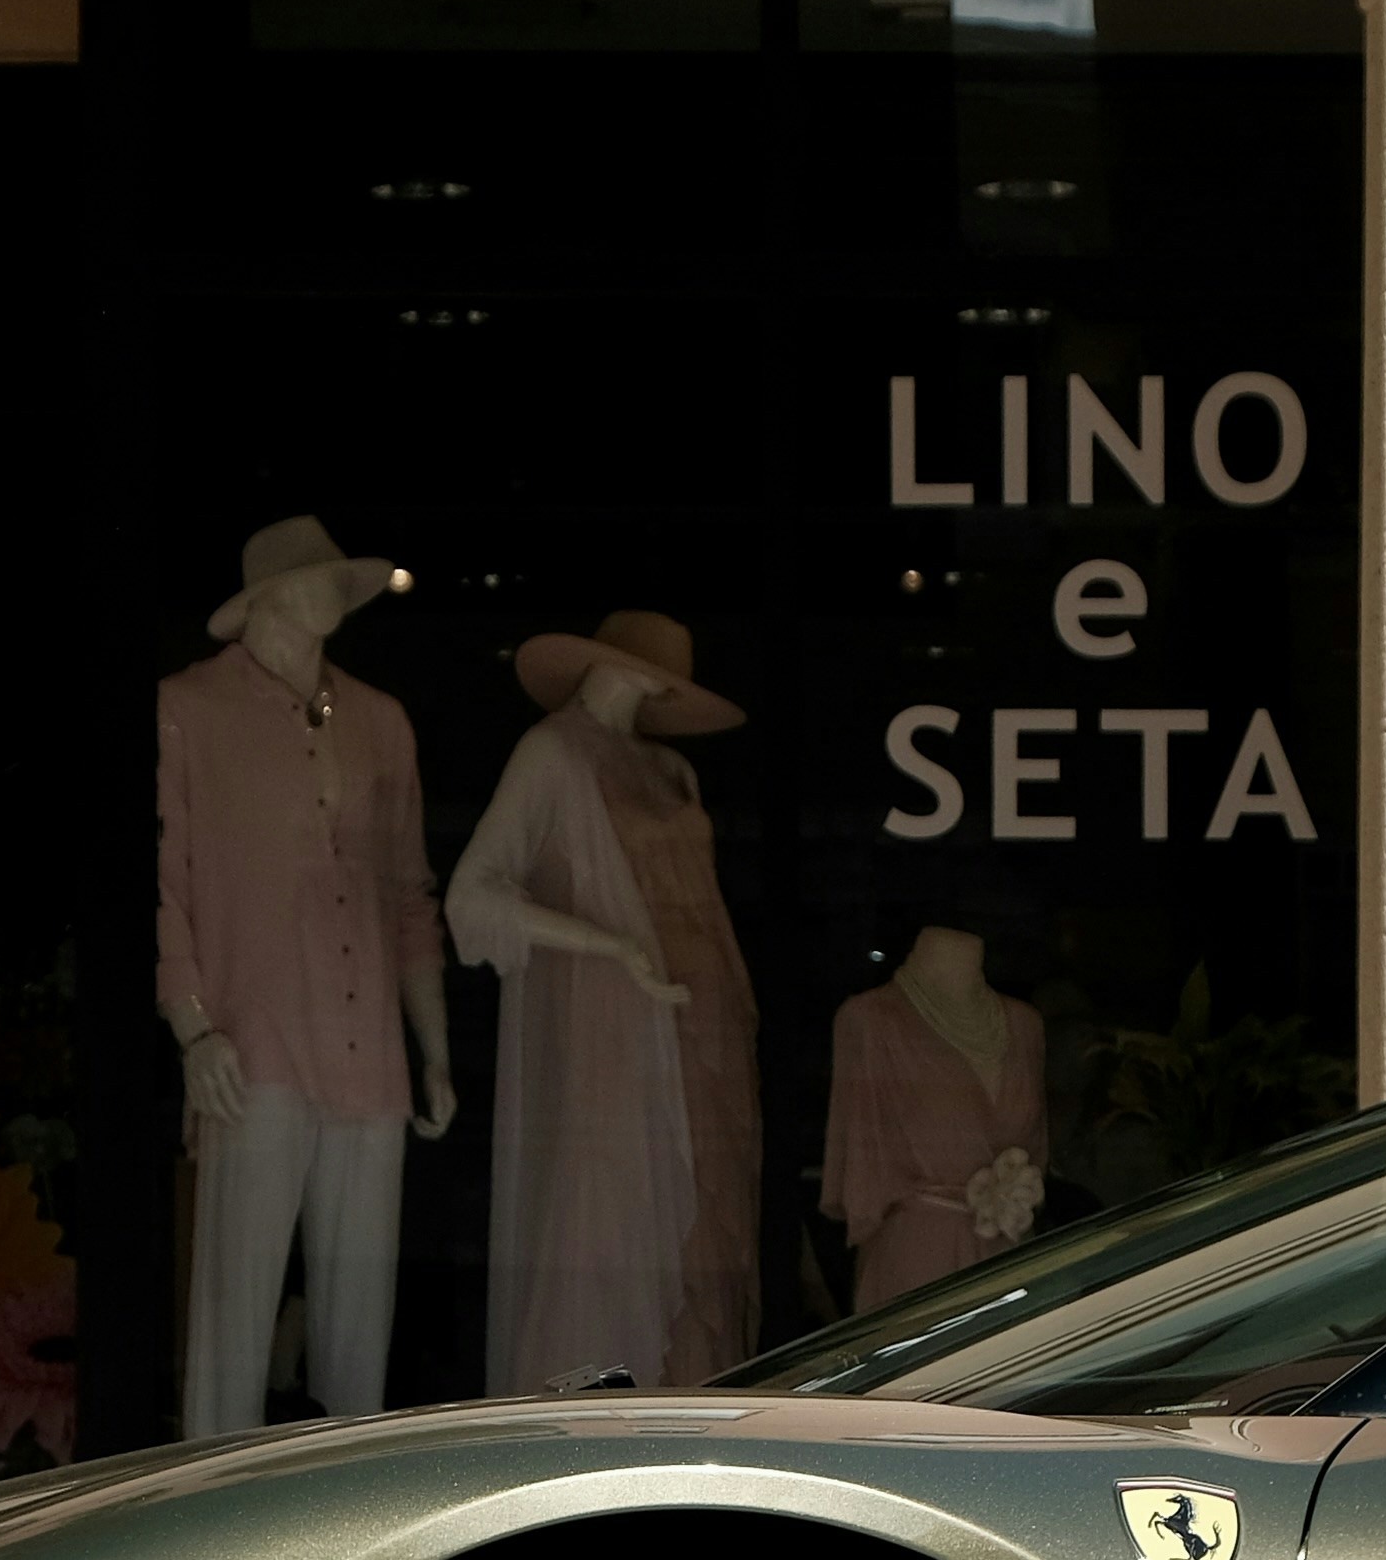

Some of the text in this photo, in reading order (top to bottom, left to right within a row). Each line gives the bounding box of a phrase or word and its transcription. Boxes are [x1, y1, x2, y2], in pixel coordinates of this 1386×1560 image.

[890, 371, 1308, 506] LINO
[1053, 558, 1149, 659] e
[883, 704, 1319, 840] SETA
